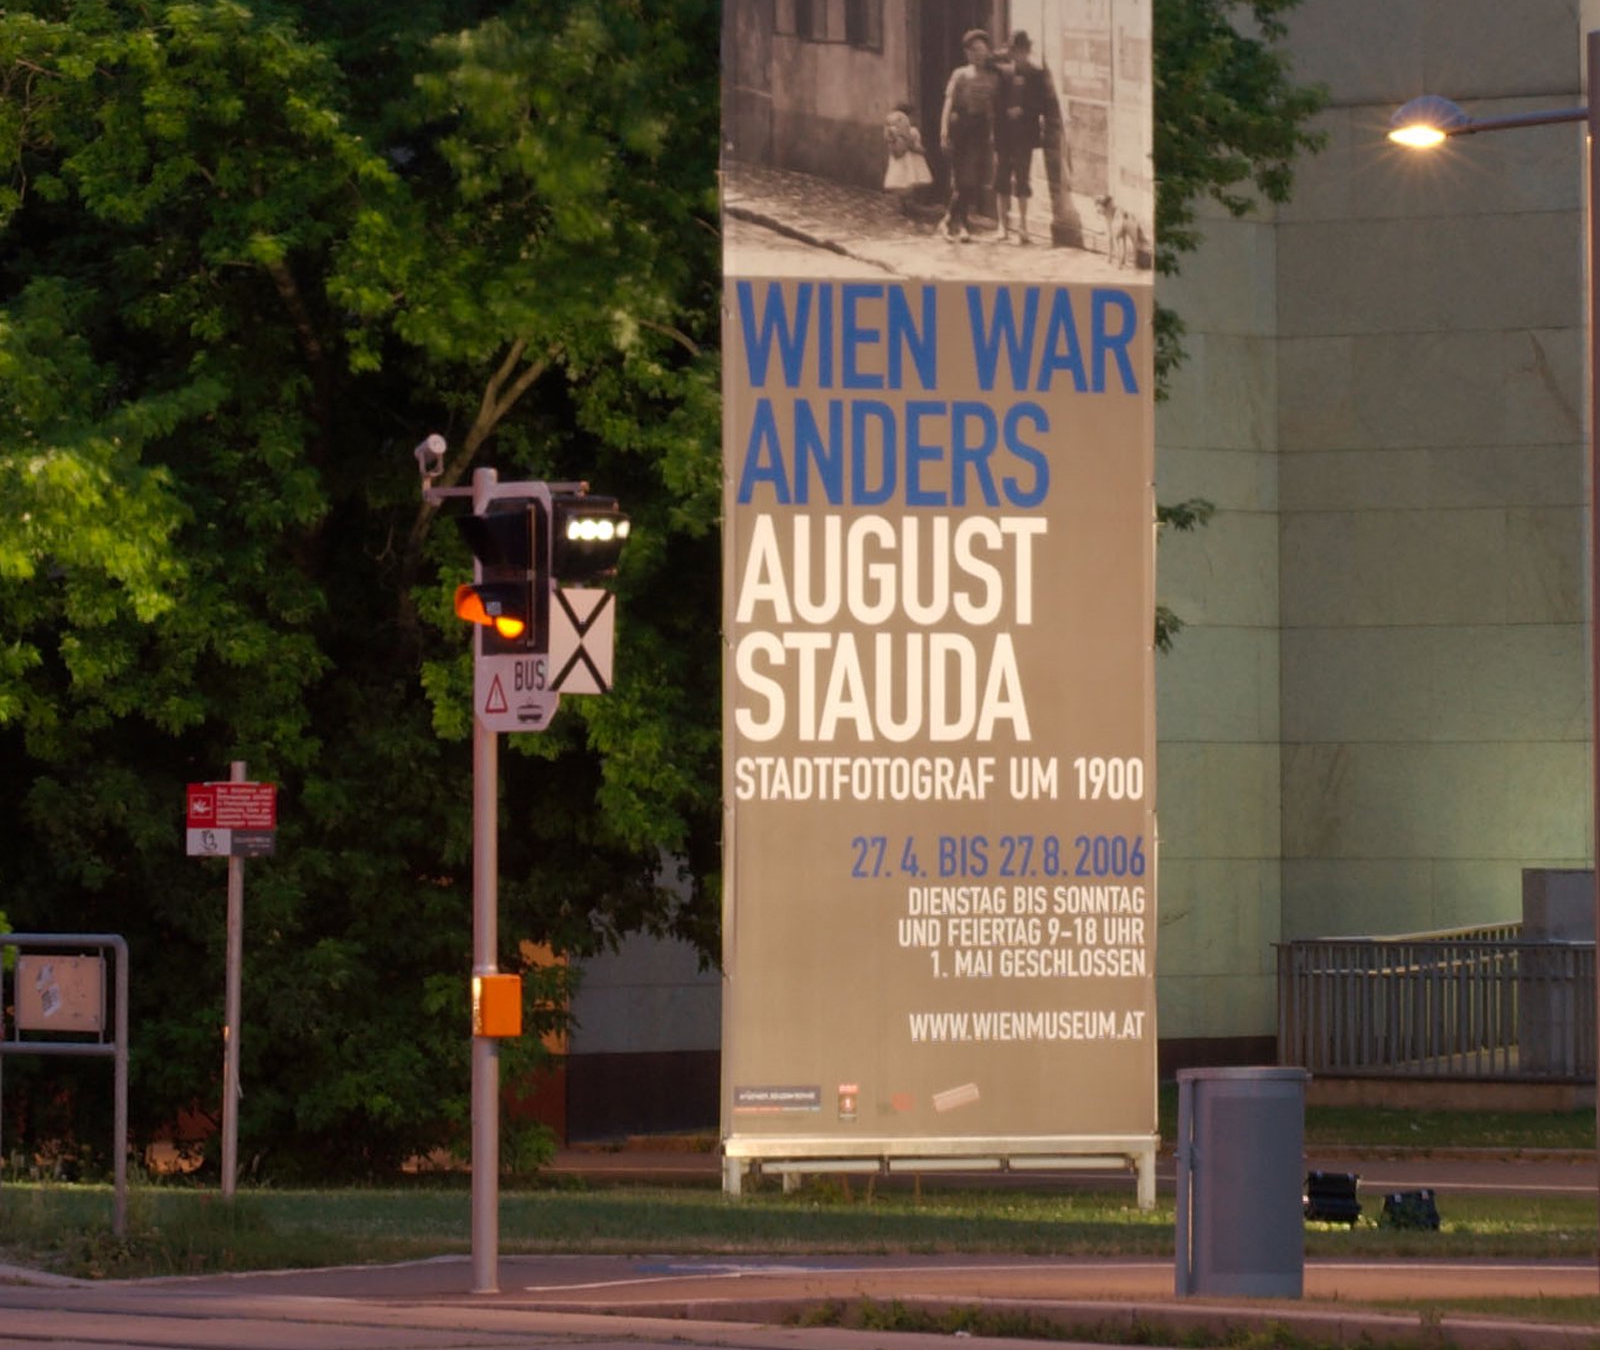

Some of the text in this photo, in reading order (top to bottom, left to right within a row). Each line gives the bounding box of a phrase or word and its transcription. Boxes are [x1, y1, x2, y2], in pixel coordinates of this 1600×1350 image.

[736, 280, 1139, 394] WIEN WAR
[737, 398, 1051, 508] ANDERS
[736, 514, 1048, 626] AUGUST
[514, 660, 545, 692] BUS
[736, 630, 1032, 742] STAUDA
[735, 757, 1144, 801] STADTFOTOGRAF UM 1900
[939, 837, 988, 877] BIS
[908, 886, 1145, 916] DIENSTAG BIS SONNTAG
[899, 919, 941, 947] UND
[948, 918, 1041, 947] FEIERTAG
[1104, 918, 1145, 945] UHR
[931, 949, 1146, 978] 1. MAI GESCHLOSSEN
[909, 1011, 1146, 1042] WWW.WIENMUSEUM.AT
